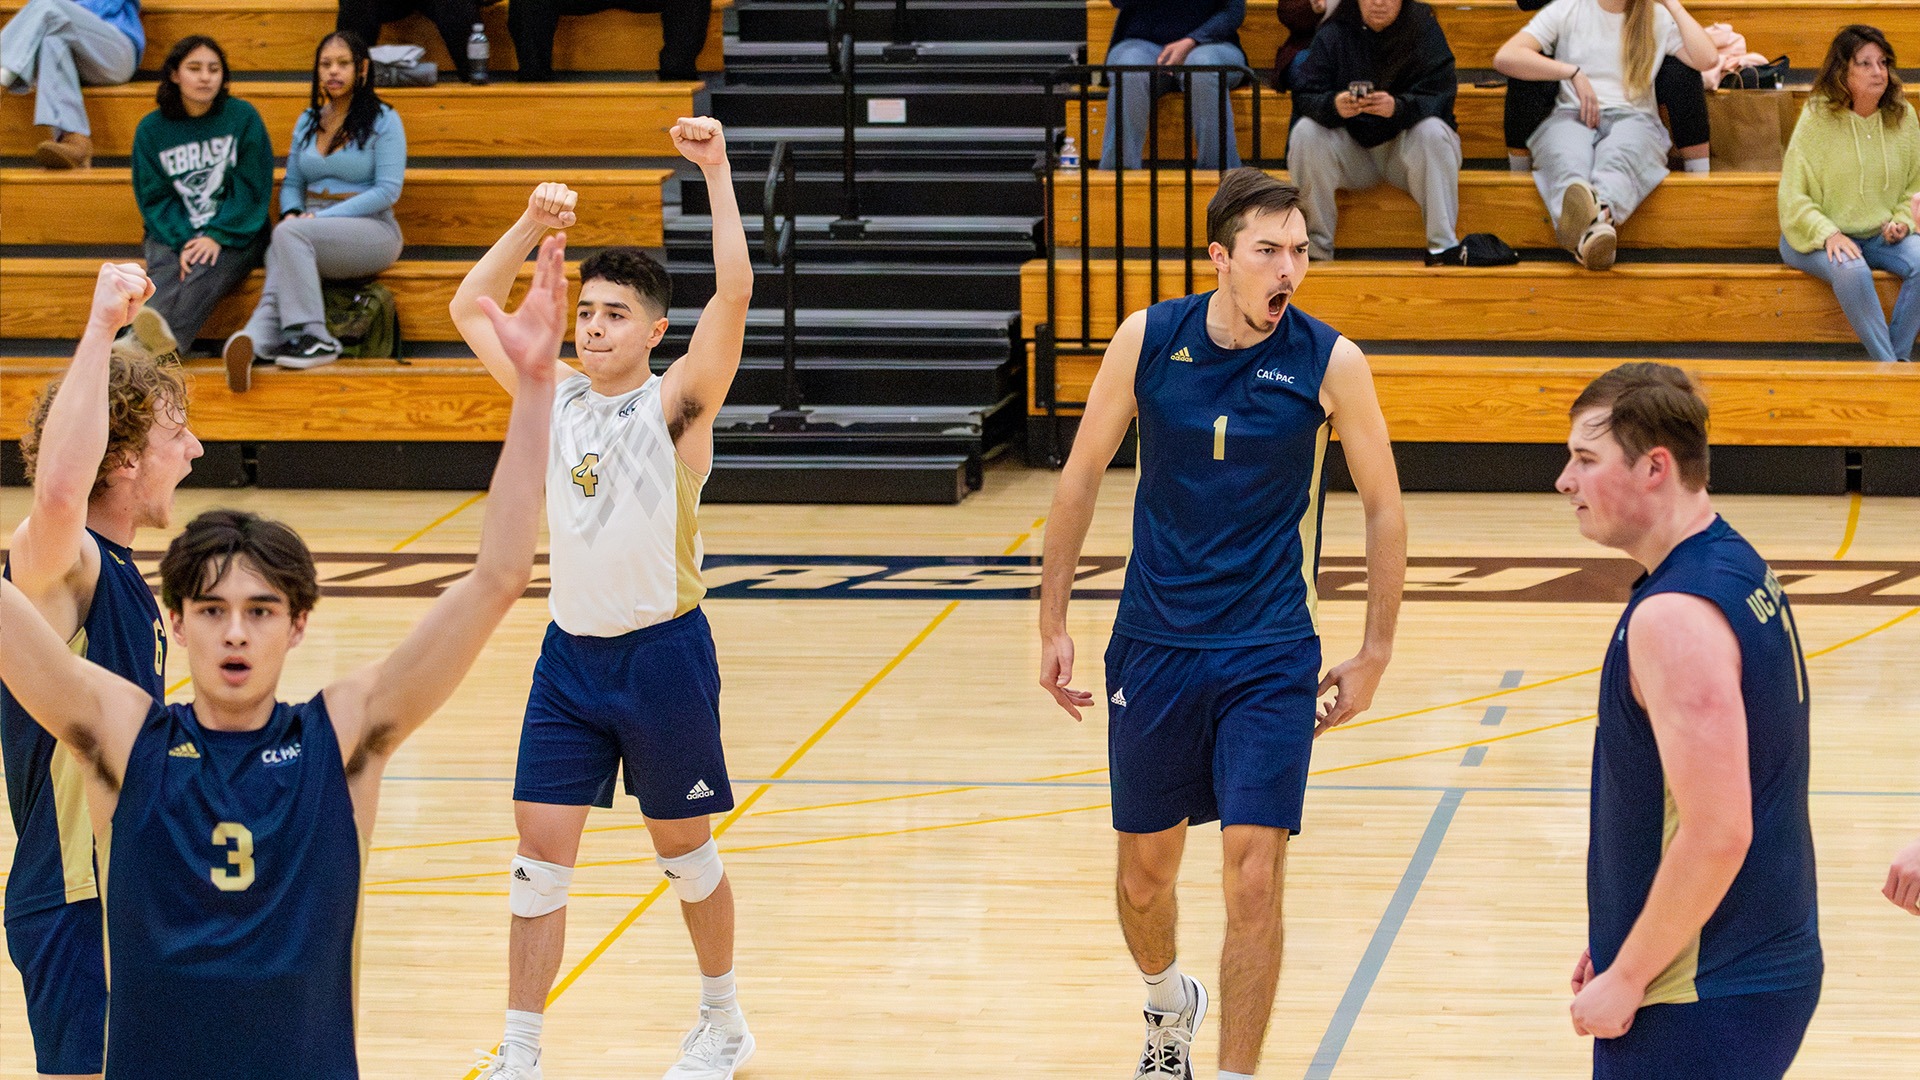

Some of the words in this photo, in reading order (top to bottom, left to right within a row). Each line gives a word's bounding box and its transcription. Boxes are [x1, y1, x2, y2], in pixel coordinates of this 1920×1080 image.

[158, 134, 238, 177] EBRAS
[1256, 368, 1275, 381] CAL
[1275, 372, 1295, 385] PAC
[1213, 415, 1228, 461] 1
[571, 452, 599, 498] 4
[1745, 587, 1777, 625] UC
[686, 789, 714, 801] adidas
[210, 822, 256, 892] 3
